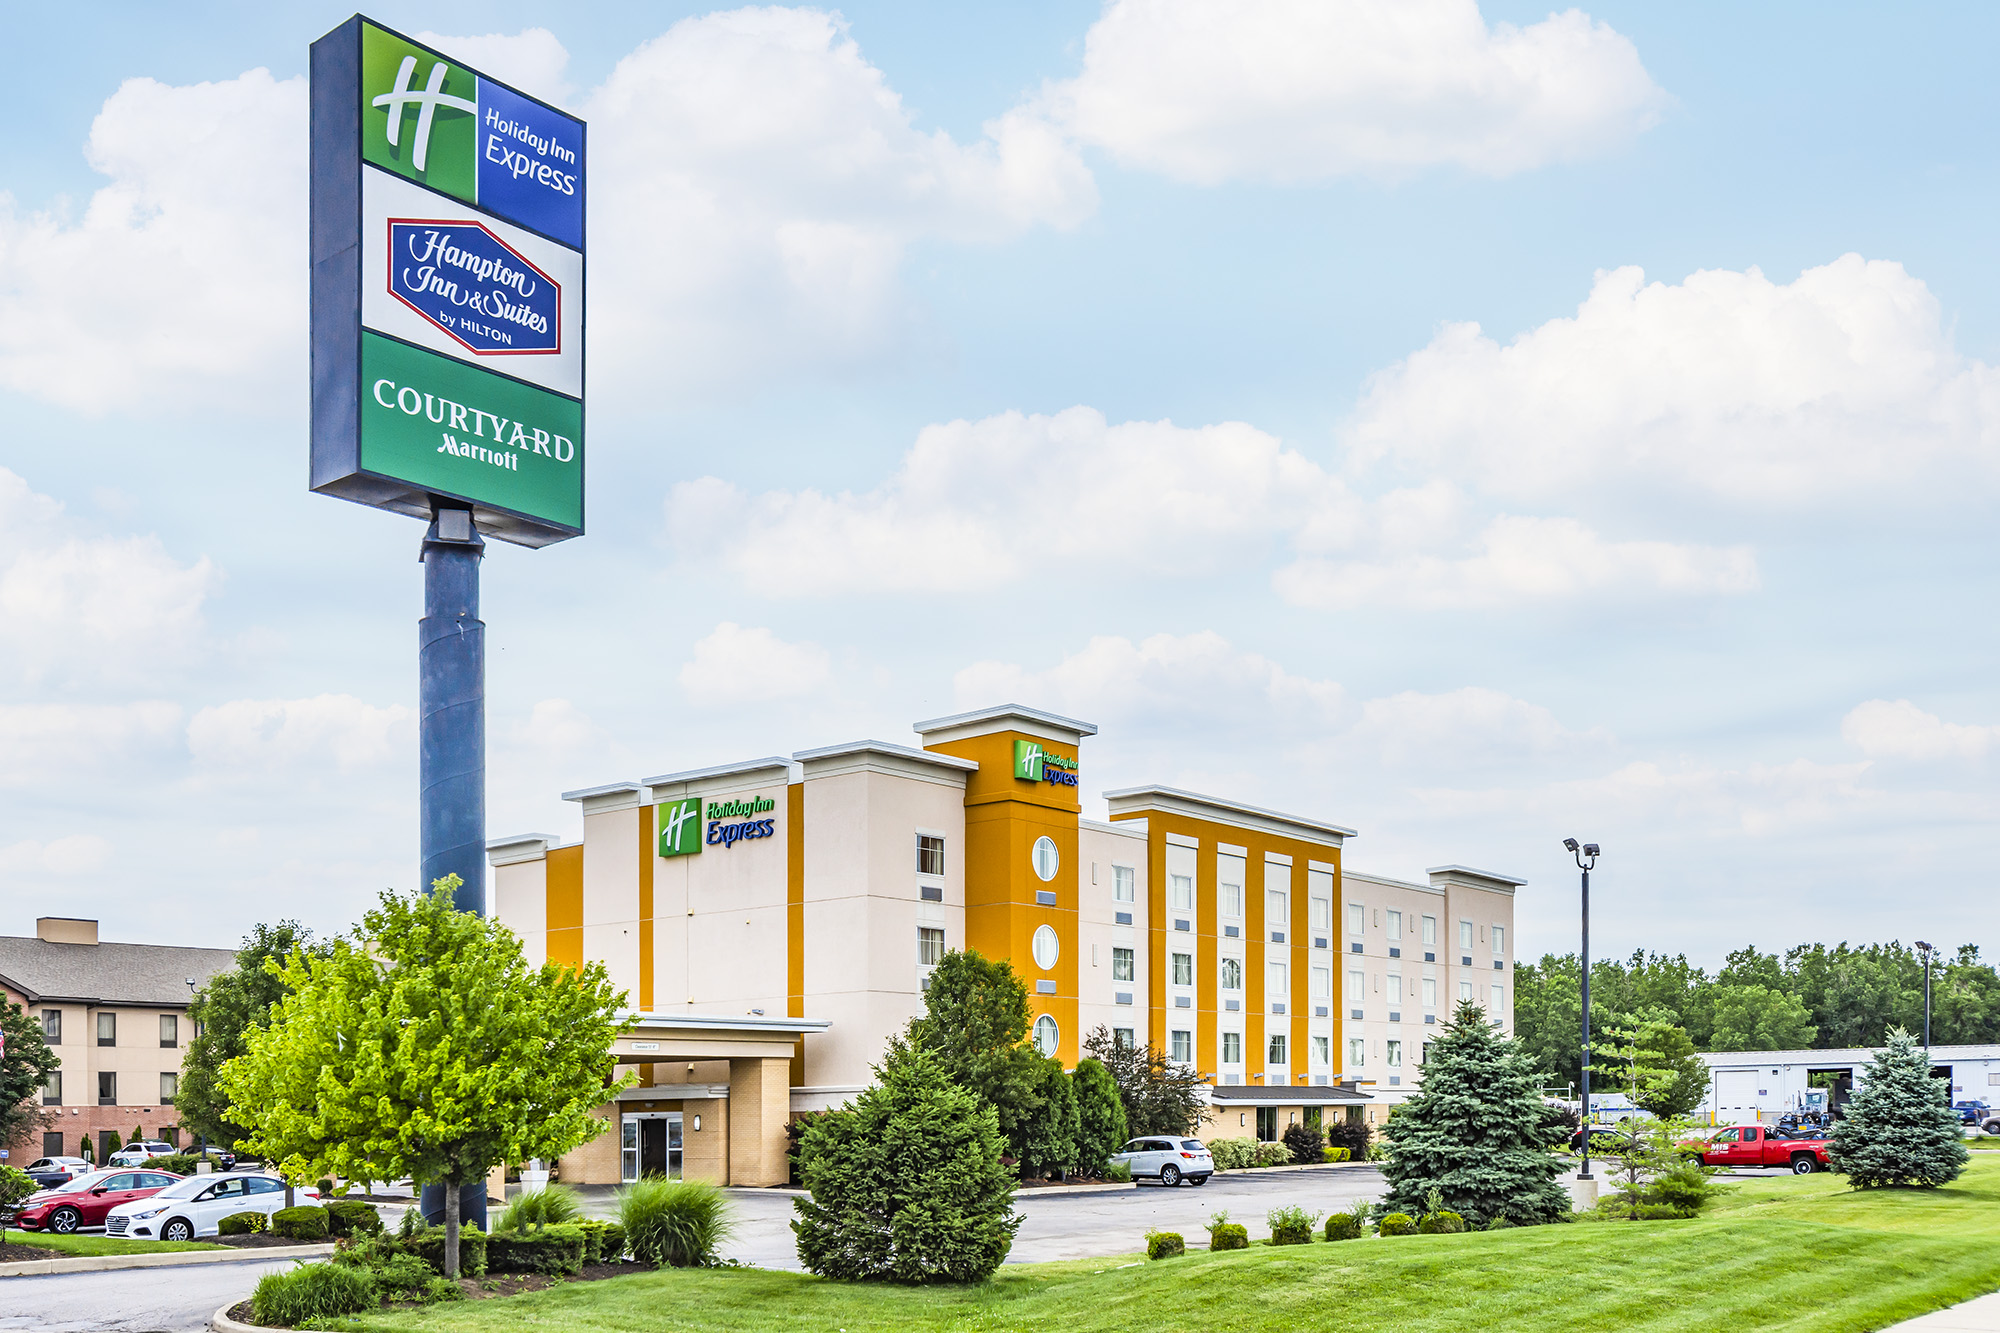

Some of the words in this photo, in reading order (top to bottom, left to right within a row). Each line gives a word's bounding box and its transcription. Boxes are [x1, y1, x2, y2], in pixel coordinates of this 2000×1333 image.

[485, 107, 548, 156] Holiday
[549, 137, 575, 165] Inn
[485, 134, 575, 195] Express
[409, 230, 535, 297] Hampton
[403, 266, 470, 305] Inn
[483, 290, 548, 334] Suites
[439, 311, 456, 327] by
[461, 318, 512, 345] HILTON
[373, 379, 575, 463] COURTYARD
[437, 433, 518, 471] Marriott
[1043, 751, 1068, 769] Holiday
[1043, 764, 1078, 786] Express
[706, 799, 753, 819] Holiday
[753, 795, 775, 812] Inn
[706, 819, 775, 848] Express
